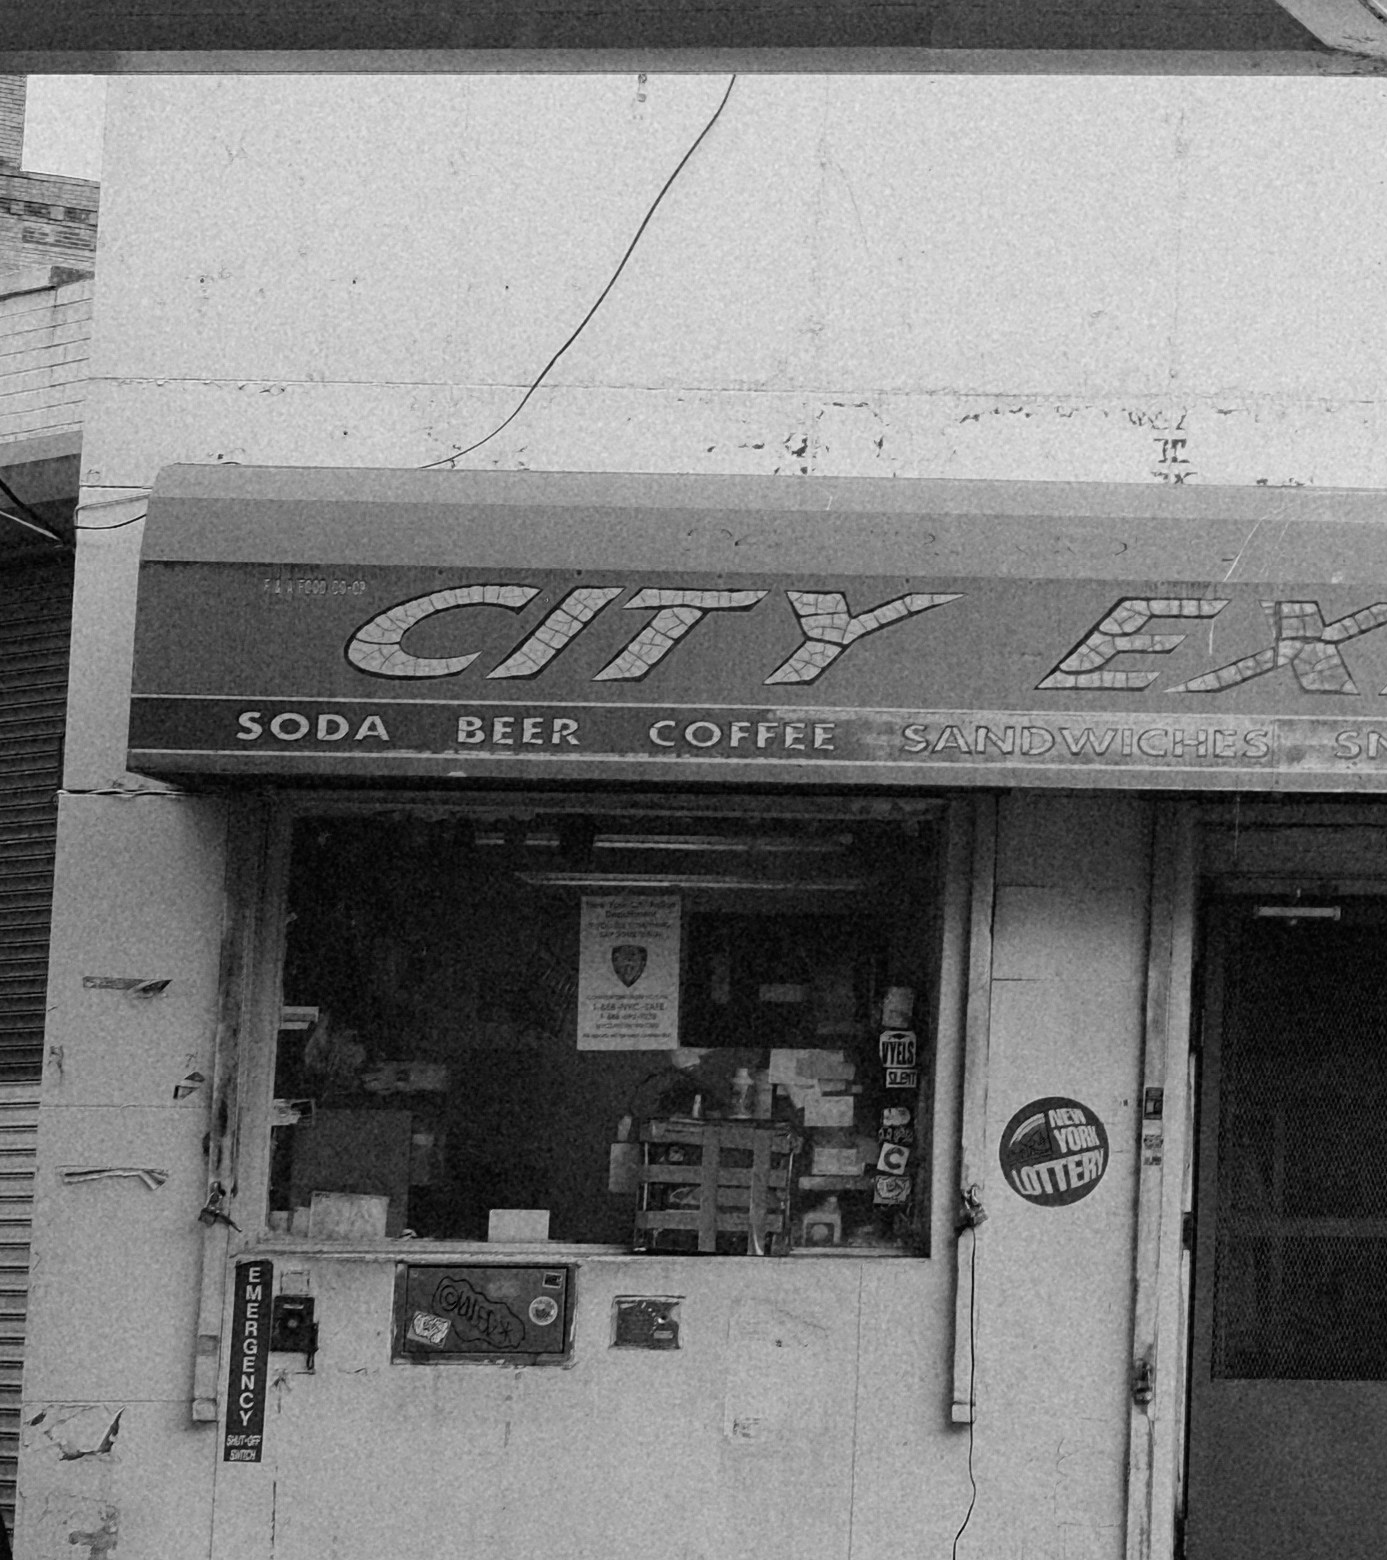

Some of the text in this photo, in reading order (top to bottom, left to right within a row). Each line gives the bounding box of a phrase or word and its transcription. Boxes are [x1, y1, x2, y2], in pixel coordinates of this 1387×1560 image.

[299, 579, 327, 595] FOOD
[343, 582, 966, 687] CITY
[235, 710, 391, 743] SODA
[456, 714, 581, 746] BEER
[649, 718, 836, 752] COFFEE
[901, 723, 1270, 759] SANDWICHES
[1048, 1107, 1087, 1128] NEW
[1053, 1125, 1100, 1154] YORK
[1011, 1147, 1105, 1196] LOTTERY
[238, 1266, 263, 1428] EMERGENCY
